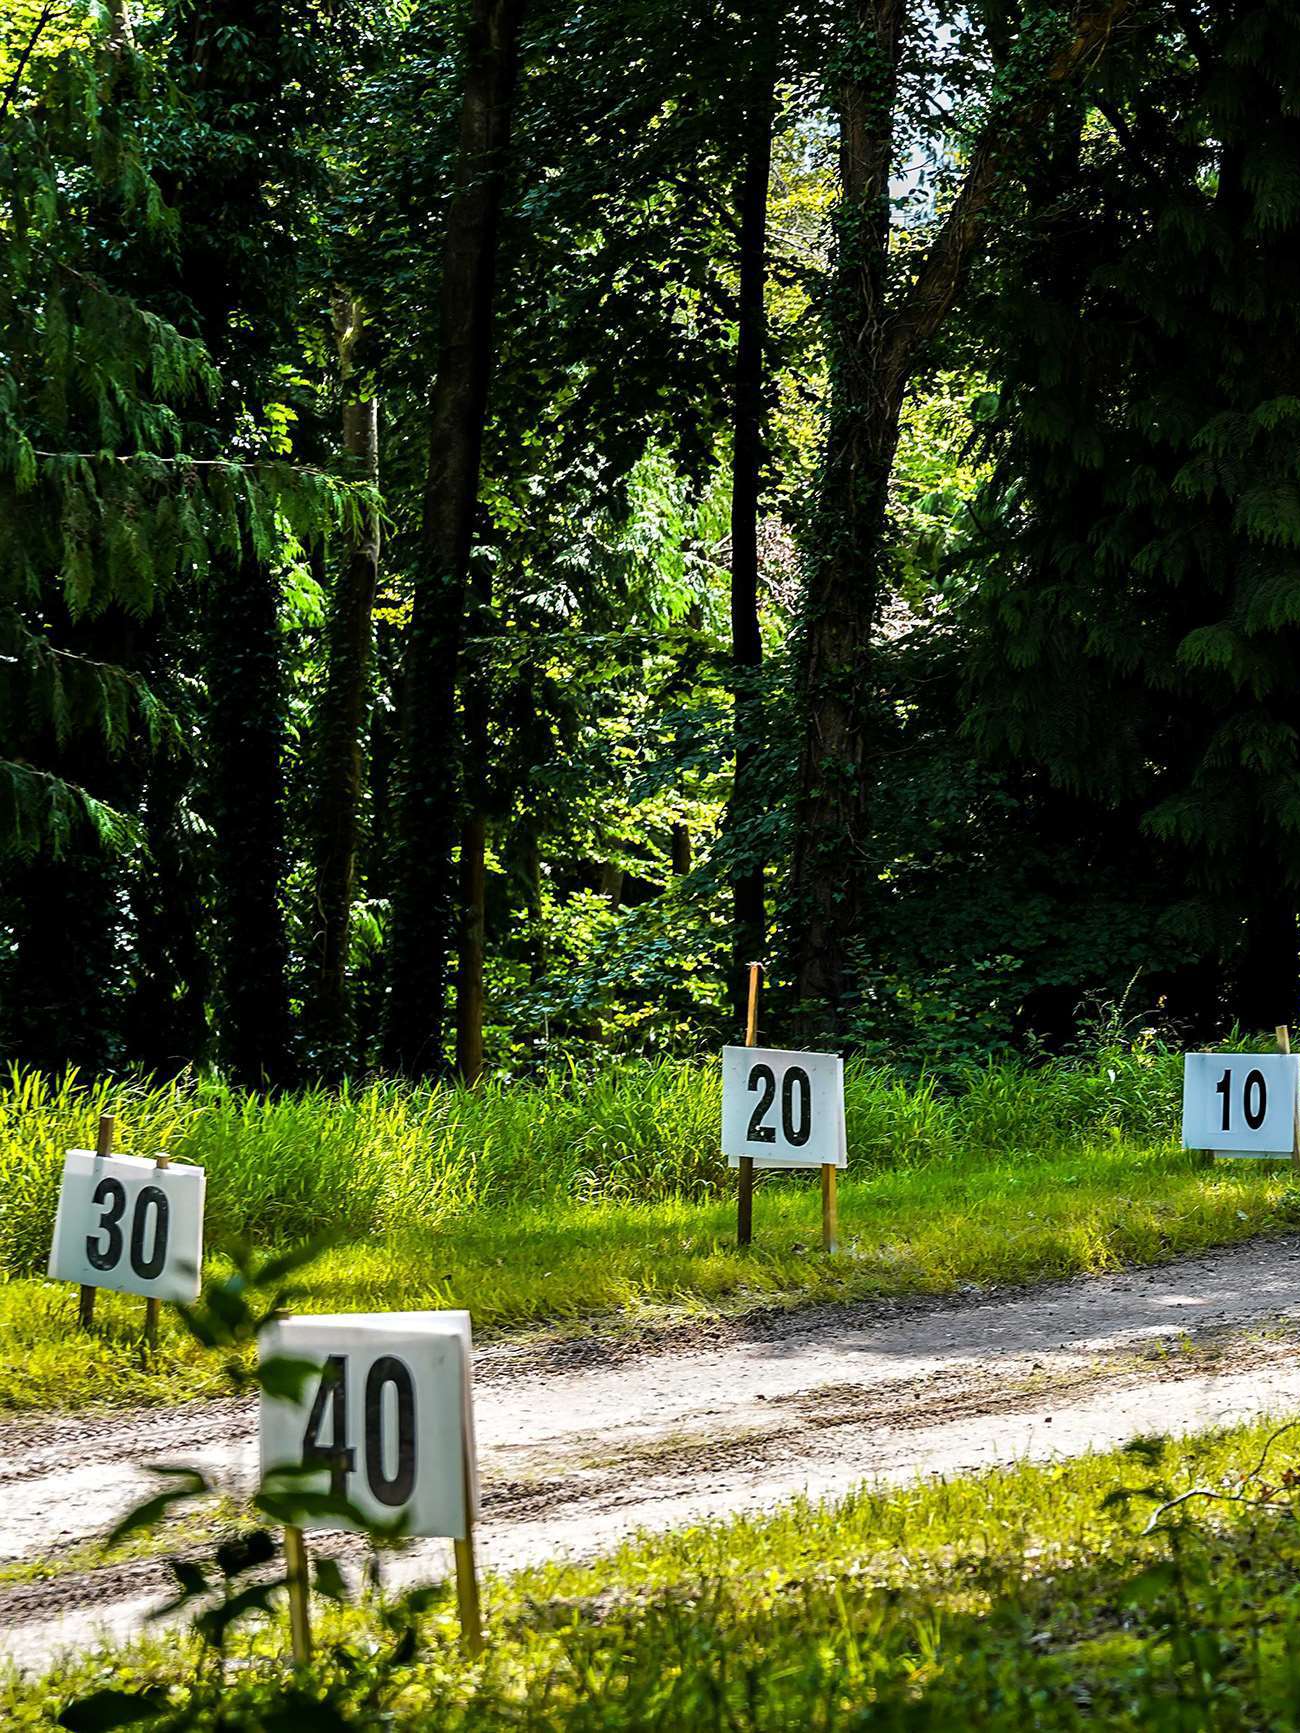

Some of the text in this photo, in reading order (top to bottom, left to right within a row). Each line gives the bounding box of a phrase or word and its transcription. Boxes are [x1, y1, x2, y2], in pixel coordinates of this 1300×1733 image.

[746, 1063, 812, 1147] 20
[1216, 1069, 1267, 1131] 10
[86, 1176, 170, 1280] 30
[303, 1355, 416, 1507] 40
